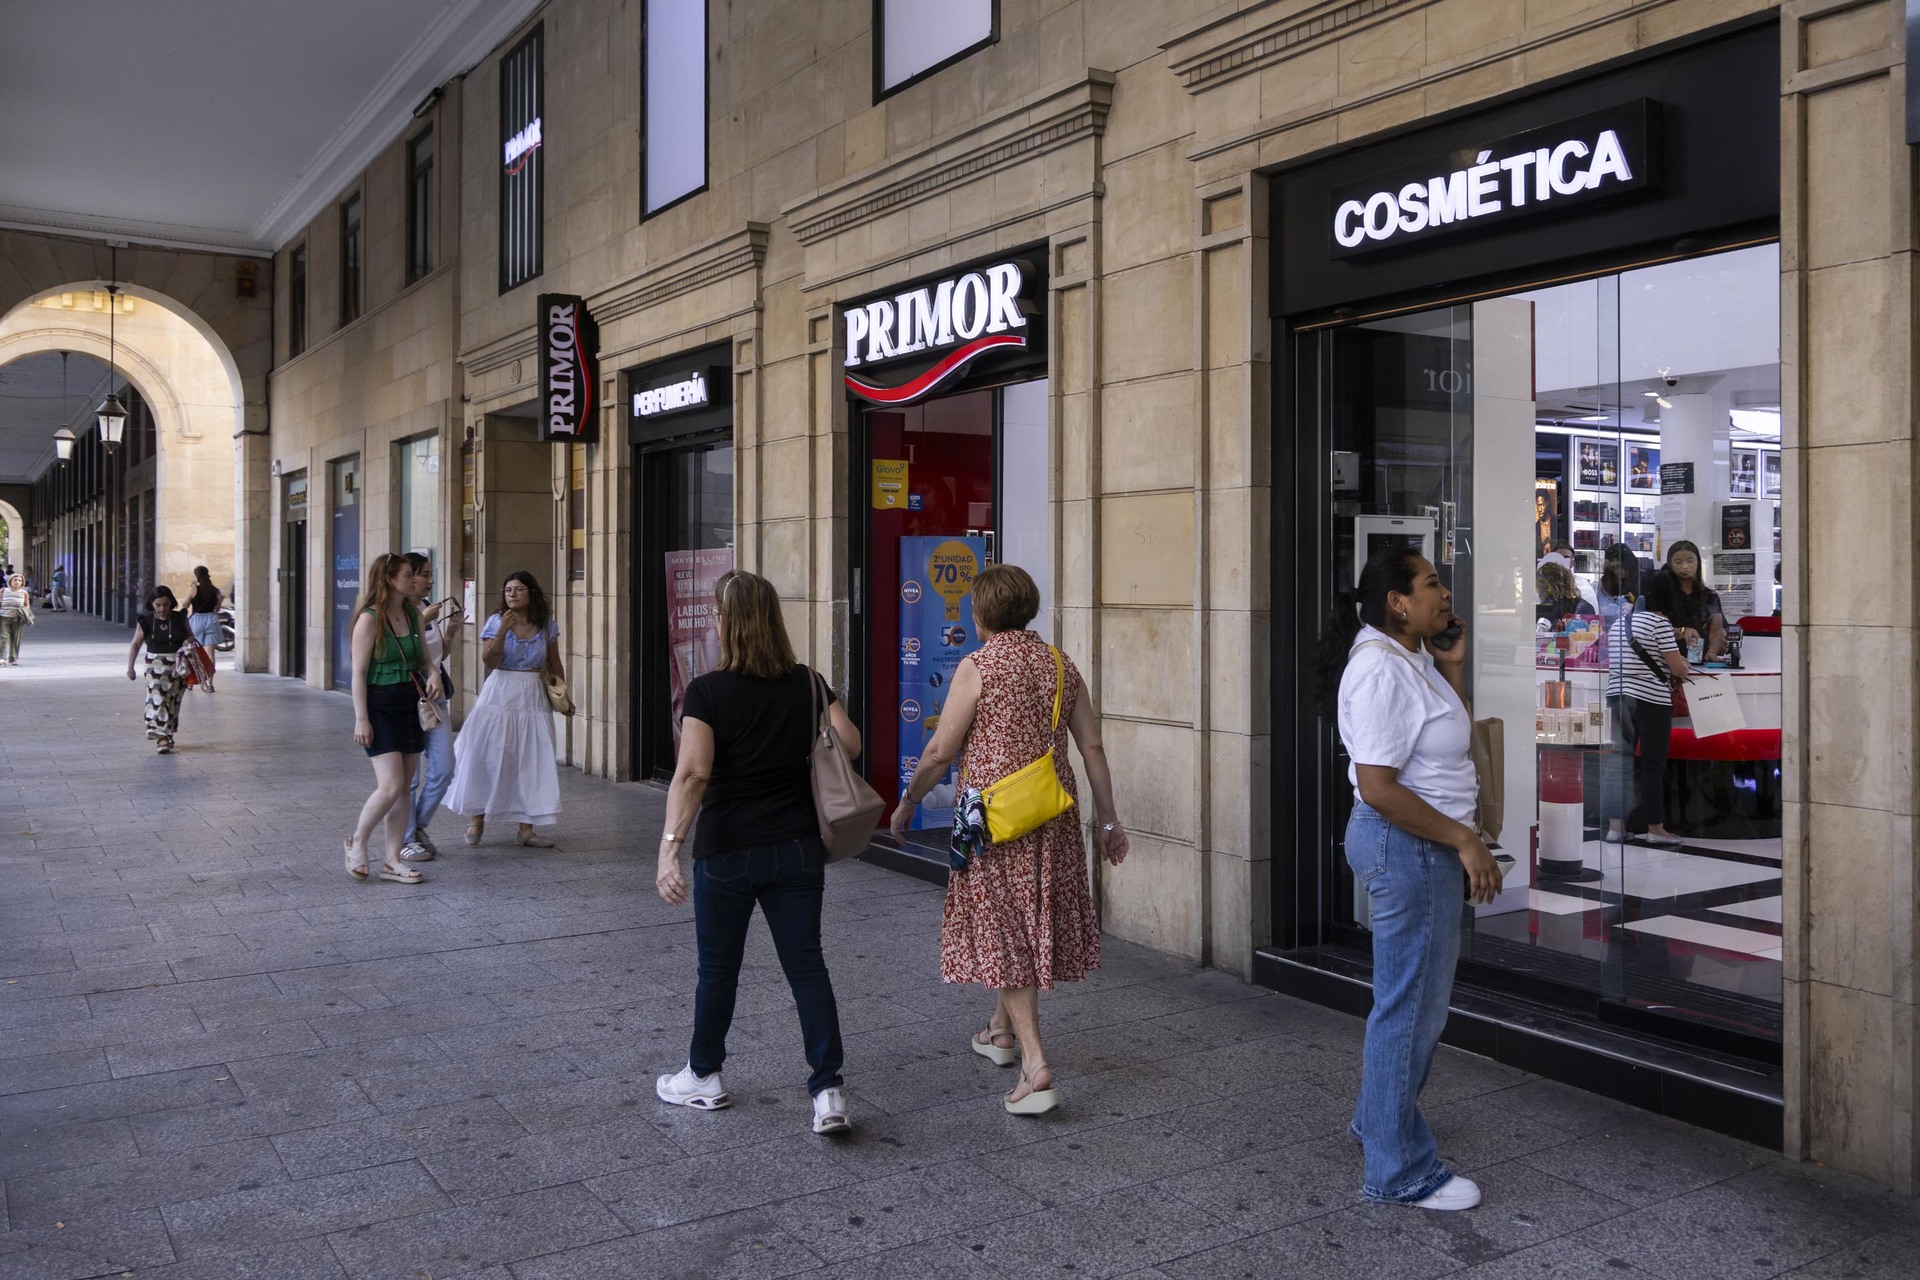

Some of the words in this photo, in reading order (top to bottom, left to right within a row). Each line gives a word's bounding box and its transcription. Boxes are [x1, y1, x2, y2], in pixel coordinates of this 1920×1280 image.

[1334, 130, 1632, 247] COSMÉTICA
[844, 263, 1026, 366] PRIMOR
[549, 303, 575, 435] PRIMOR
[633, 371, 708, 417] PERFUMERÍA
[876, 463, 905, 474] Glovo
[1583, 468, 1598, 477] BOSS
[672, 555, 727, 564] MAYBELLINE
[676, 571, 693, 579] NUEVO
[934, 564, 957, 583] 70
[677, 604, 708, 617] LABIOS
[678, 617, 706, 630] MUCHO
